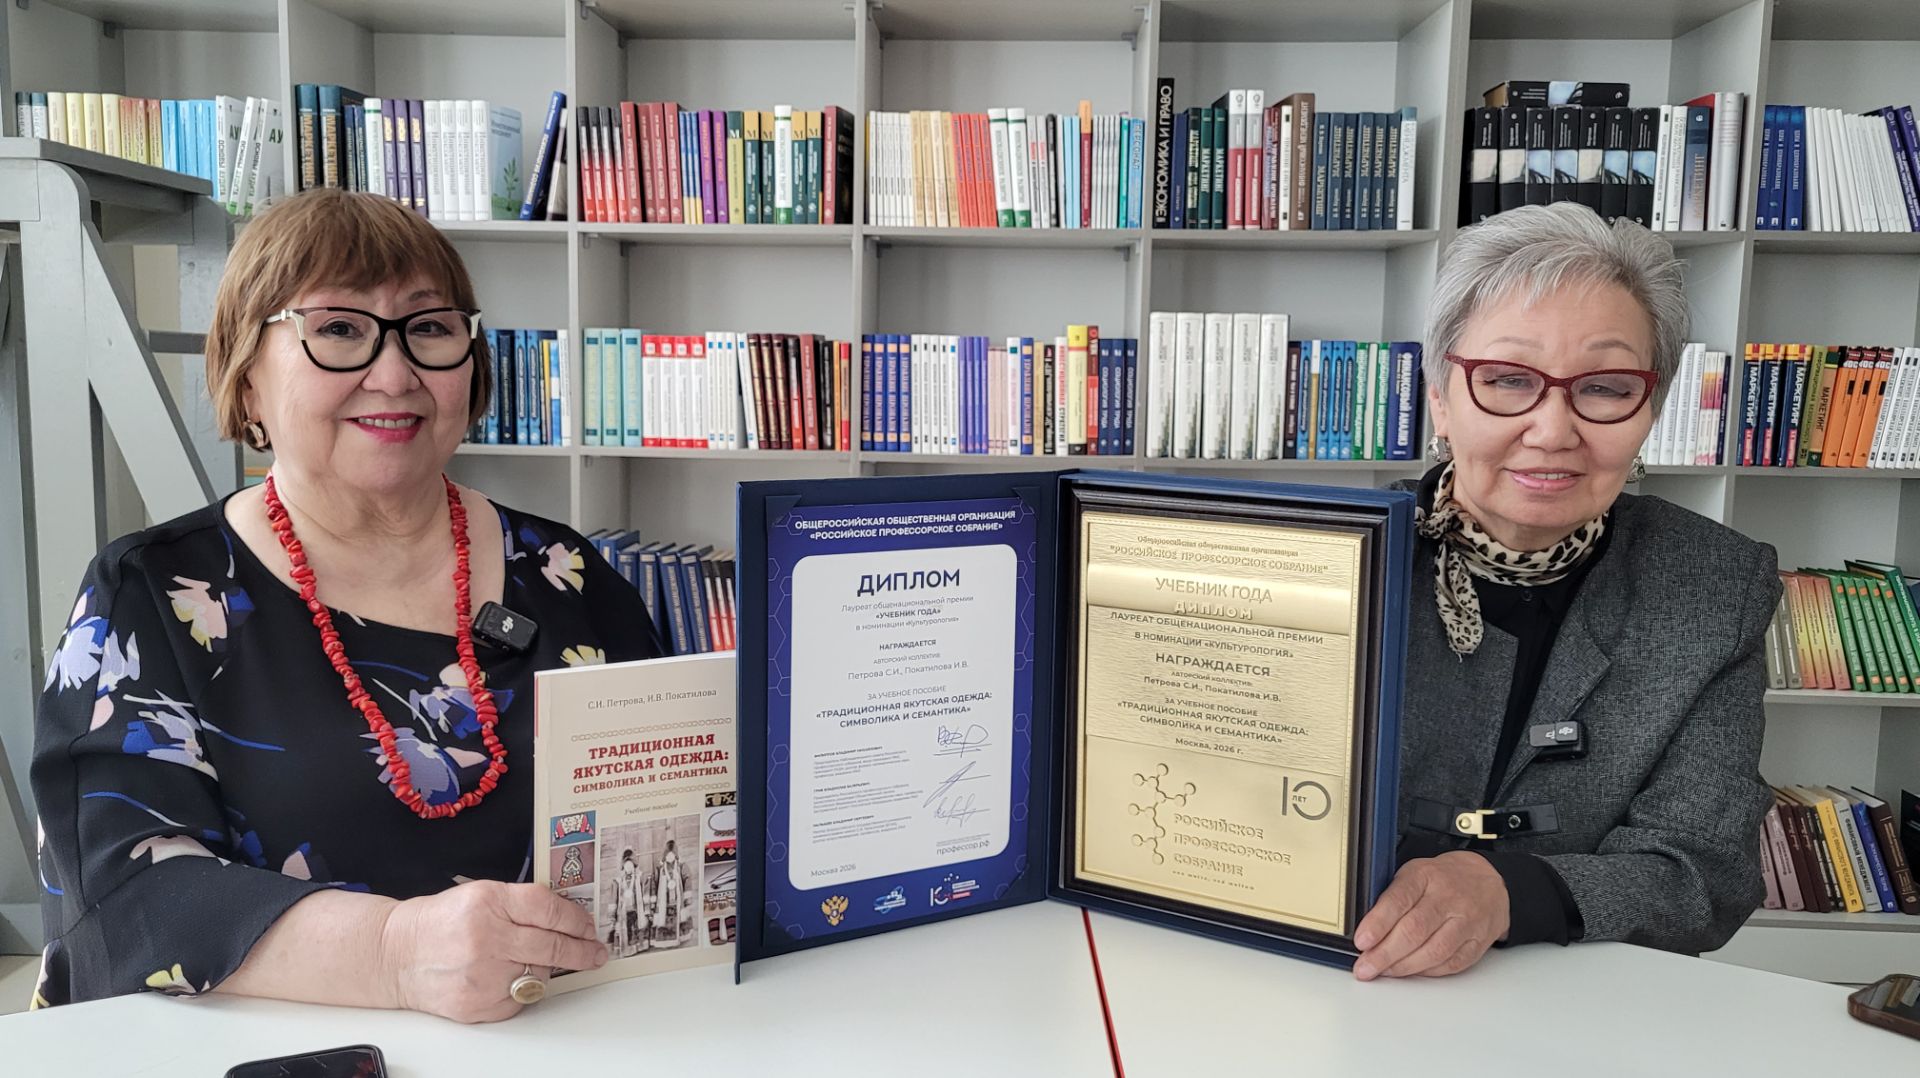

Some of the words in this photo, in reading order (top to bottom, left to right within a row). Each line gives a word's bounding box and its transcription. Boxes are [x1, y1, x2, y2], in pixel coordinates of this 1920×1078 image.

[1159, 85, 1172, 125] ПРАВО
[1159, 127, 1170, 138] И
[303, 115, 315, 182] МАРКЕТИНГ
[326, 115, 338, 183] МАРКЕТИНГ
[1131, 124, 1142, 170] ПЕРСОНАЛ
[1155, 138, 1170, 217] ЭКОНОМИКА
[1200, 148, 1210, 193] МАРКЕТИНГ
[1214, 148, 1224, 193] МАРКЕТИНГ
[1101, 366, 1109, 409] СОЦИОЛОГИЯ
[1113, 366, 1121, 409] СОЦИОЛОГИЯ
[1126, 366, 1134, 409] СОЦИОЛОГИЯ
[1746, 366, 1758, 426] МАРКЕТИНГ
[1766, 366, 1779, 426] МАРКЕТИНГ
[1790, 366, 1807, 427] МАРКЕТИНГ
[1113, 409, 1121, 429] ТРУДА
[1815, 386, 1831, 432] МАРКЕТИНГ
[795, 516, 885, 530] ОБЩЕРОССИЙСКАЯ
[886, 513, 957, 526] ОБЩЕСТВЕННАЯ
[957, 510, 1016, 522] ОРГАНИЗАЦИЯ
[810, 528, 877, 540] «РОССИЙСКОЕ
[879, 524, 954, 537] ПРОФЕССОРСКОЕ
[955, 521, 1003, 533] СОБРАНИЕ»
[1137, 535, 1197, 548] Общероссийская
[1110, 544, 1177, 560] "РОССИЙСКОЕ
[1181, 552, 1267, 568] ПРОФЕССОРСКОЕ
[1268, 560, 1329, 575] СОБРАНИЕ"
[856, 568, 961, 598] ДИПЛОМ
[1155, 577, 1228, 598] УЧЕБНИК
[1231, 585, 1273, 604] ГОДА
[841, 603, 872, 613] Лауреат
[872, 597, 945, 610] общенациональной
[946, 595, 974, 605] премии
[875, 609, 915, 620] «УЧЕБНИК
[917, 608, 941, 617] ГОДА»
[1173, 600, 1254, 620] ДИПЛОМ
[861, 621, 905, 631] номинации
[1110, 611, 1154, 625] ЛАУРЕАТ
[1156, 616, 1275, 639] ОБЩЕНАЦИОНАЛЬНОЙ
[1277, 631, 1324, 645] ПРЕМИИ
[879, 639, 937, 651] НАГРАЖДАЕТСЯ
[1134, 631, 1141, 639] В
[1143, 631, 1202, 648] НОМИНАЦИИ
[1204, 639, 1294, 659] «КУЛЬТУРОЛОГИЯ»
[847, 670, 884, 680] Петрова
[904, 662, 952, 675] Покатилова
[953, 660, 969, 669] И.В.
[1155, 652, 1271, 677] НАГРАЖДАЕТСЯ
[588, 700, 605, 709] С.И.
[607, 697, 645, 710] Петрова,
[647, 693, 664, 703] И.В.
[665, 688, 717, 701] Покатилова
[867, 693, 877, 701] ЗА
[878, 689, 912, 700] УЧЕБНОЕ
[912, 685, 947, 696] ПОСОБИЕ
[1144, 676, 1182, 690] Петрова
[1183, 681, 1203, 693] С.И.,
[1205, 684, 1261, 700] Покатилова
[1263, 692, 1282, 703] И.В.
[816, 702, 901, 720] «ТРАДИЦИОННАЯ
[903, 696, 950, 709] ЯКУТСКАЯ
[951, 691, 993, 705] ОДЕЖДА:
[839, 713, 900, 728] СИМВОЛИКА
[902, 712, 910, 721] И
[911, 706, 971, 721] СЕМАНТИКА»
[1117, 700, 1203, 720] «ТРАДИЦИОННАЯ
[1205, 711, 1257, 728] ЯКУТСКАЯ
[1258, 721, 1309, 737] ОДЕЖДА:
[1164, 697, 1174, 705] ЗА
[1176, 698, 1216, 711] УЧЕБНОЕ
[1217, 704, 1258, 717] ПОСОБИЕ
[1140, 714, 1202, 732] СИМВОЛИКА
[1205, 724, 1212, 733] И
[1214, 726, 1283, 744] СЕМАНТИКА»
[588, 733, 716, 760] ТРАДИЦИОННАЯ
[1175, 737, 1211, 750] Москва,
[1213, 742, 1235, 754] 2026
[1236, 747, 1244, 755] г.
[572, 757, 655, 780] ЯКУТСКАЯ
[659, 749, 730, 768] ОДЕЖДА:
[572, 774, 645, 795] СИМВОЛИКА
[648, 774, 656, 783] И
[659, 765, 728, 782] СЕМАНТИКА
[624, 805, 651, 816] Учебное
[651, 802, 678, 813] пособие
[1291, 794, 1307, 804] ЛЕТ
[1174, 813, 1264, 840] РОССИЙСКОЕ
[936, 839, 990, 856] профессор.рф
[1174, 832, 1292, 866] ПРОФЕССОРСКОЕ
[810, 865, 838, 878] Москва
[839, 863, 857, 873] 2026
[1174, 852, 1244, 877] СОБРАНИЕ
[1856, 853, 1872, 893] МЕНЕДЖМЕНТ
